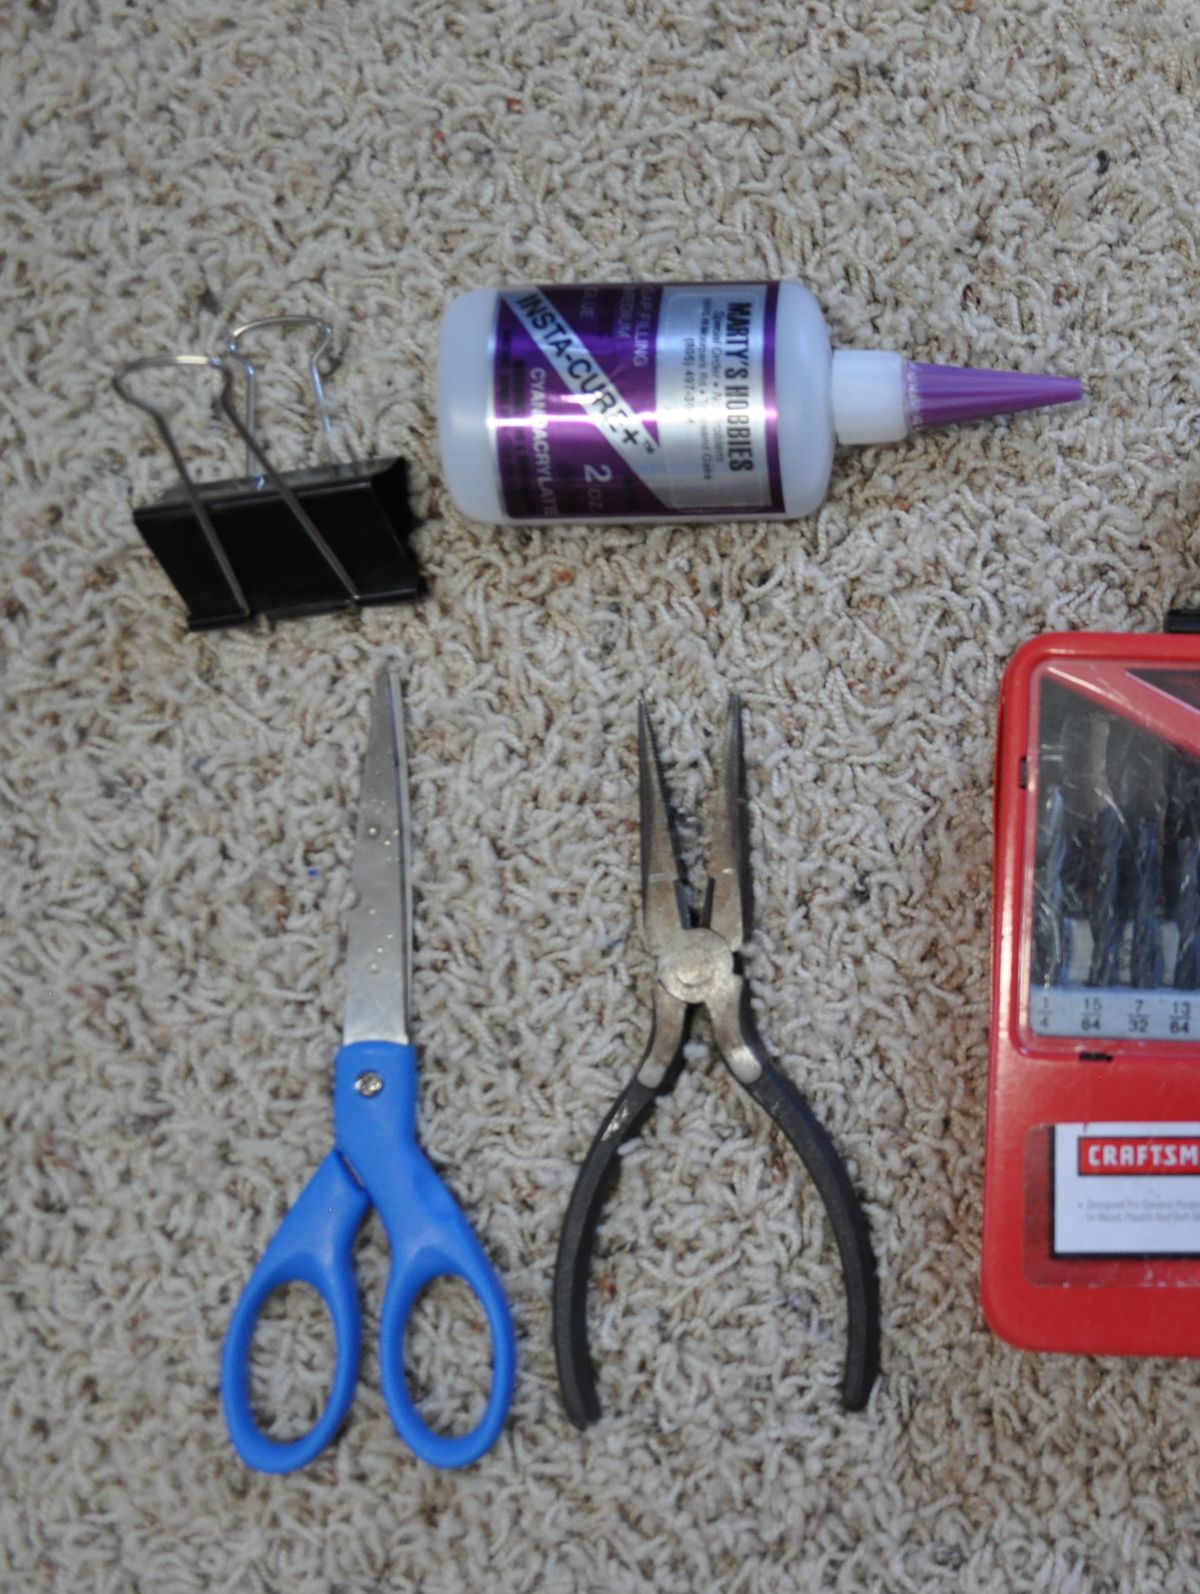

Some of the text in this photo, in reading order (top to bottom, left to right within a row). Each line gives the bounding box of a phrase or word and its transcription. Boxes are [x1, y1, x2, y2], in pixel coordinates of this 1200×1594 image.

[633, 313, 650, 367] FILLING
[711, 347, 721, 378] Order
[725, 302, 754, 471] MARTY'S HOBBIES
[584, 464, 613, 483] 2
